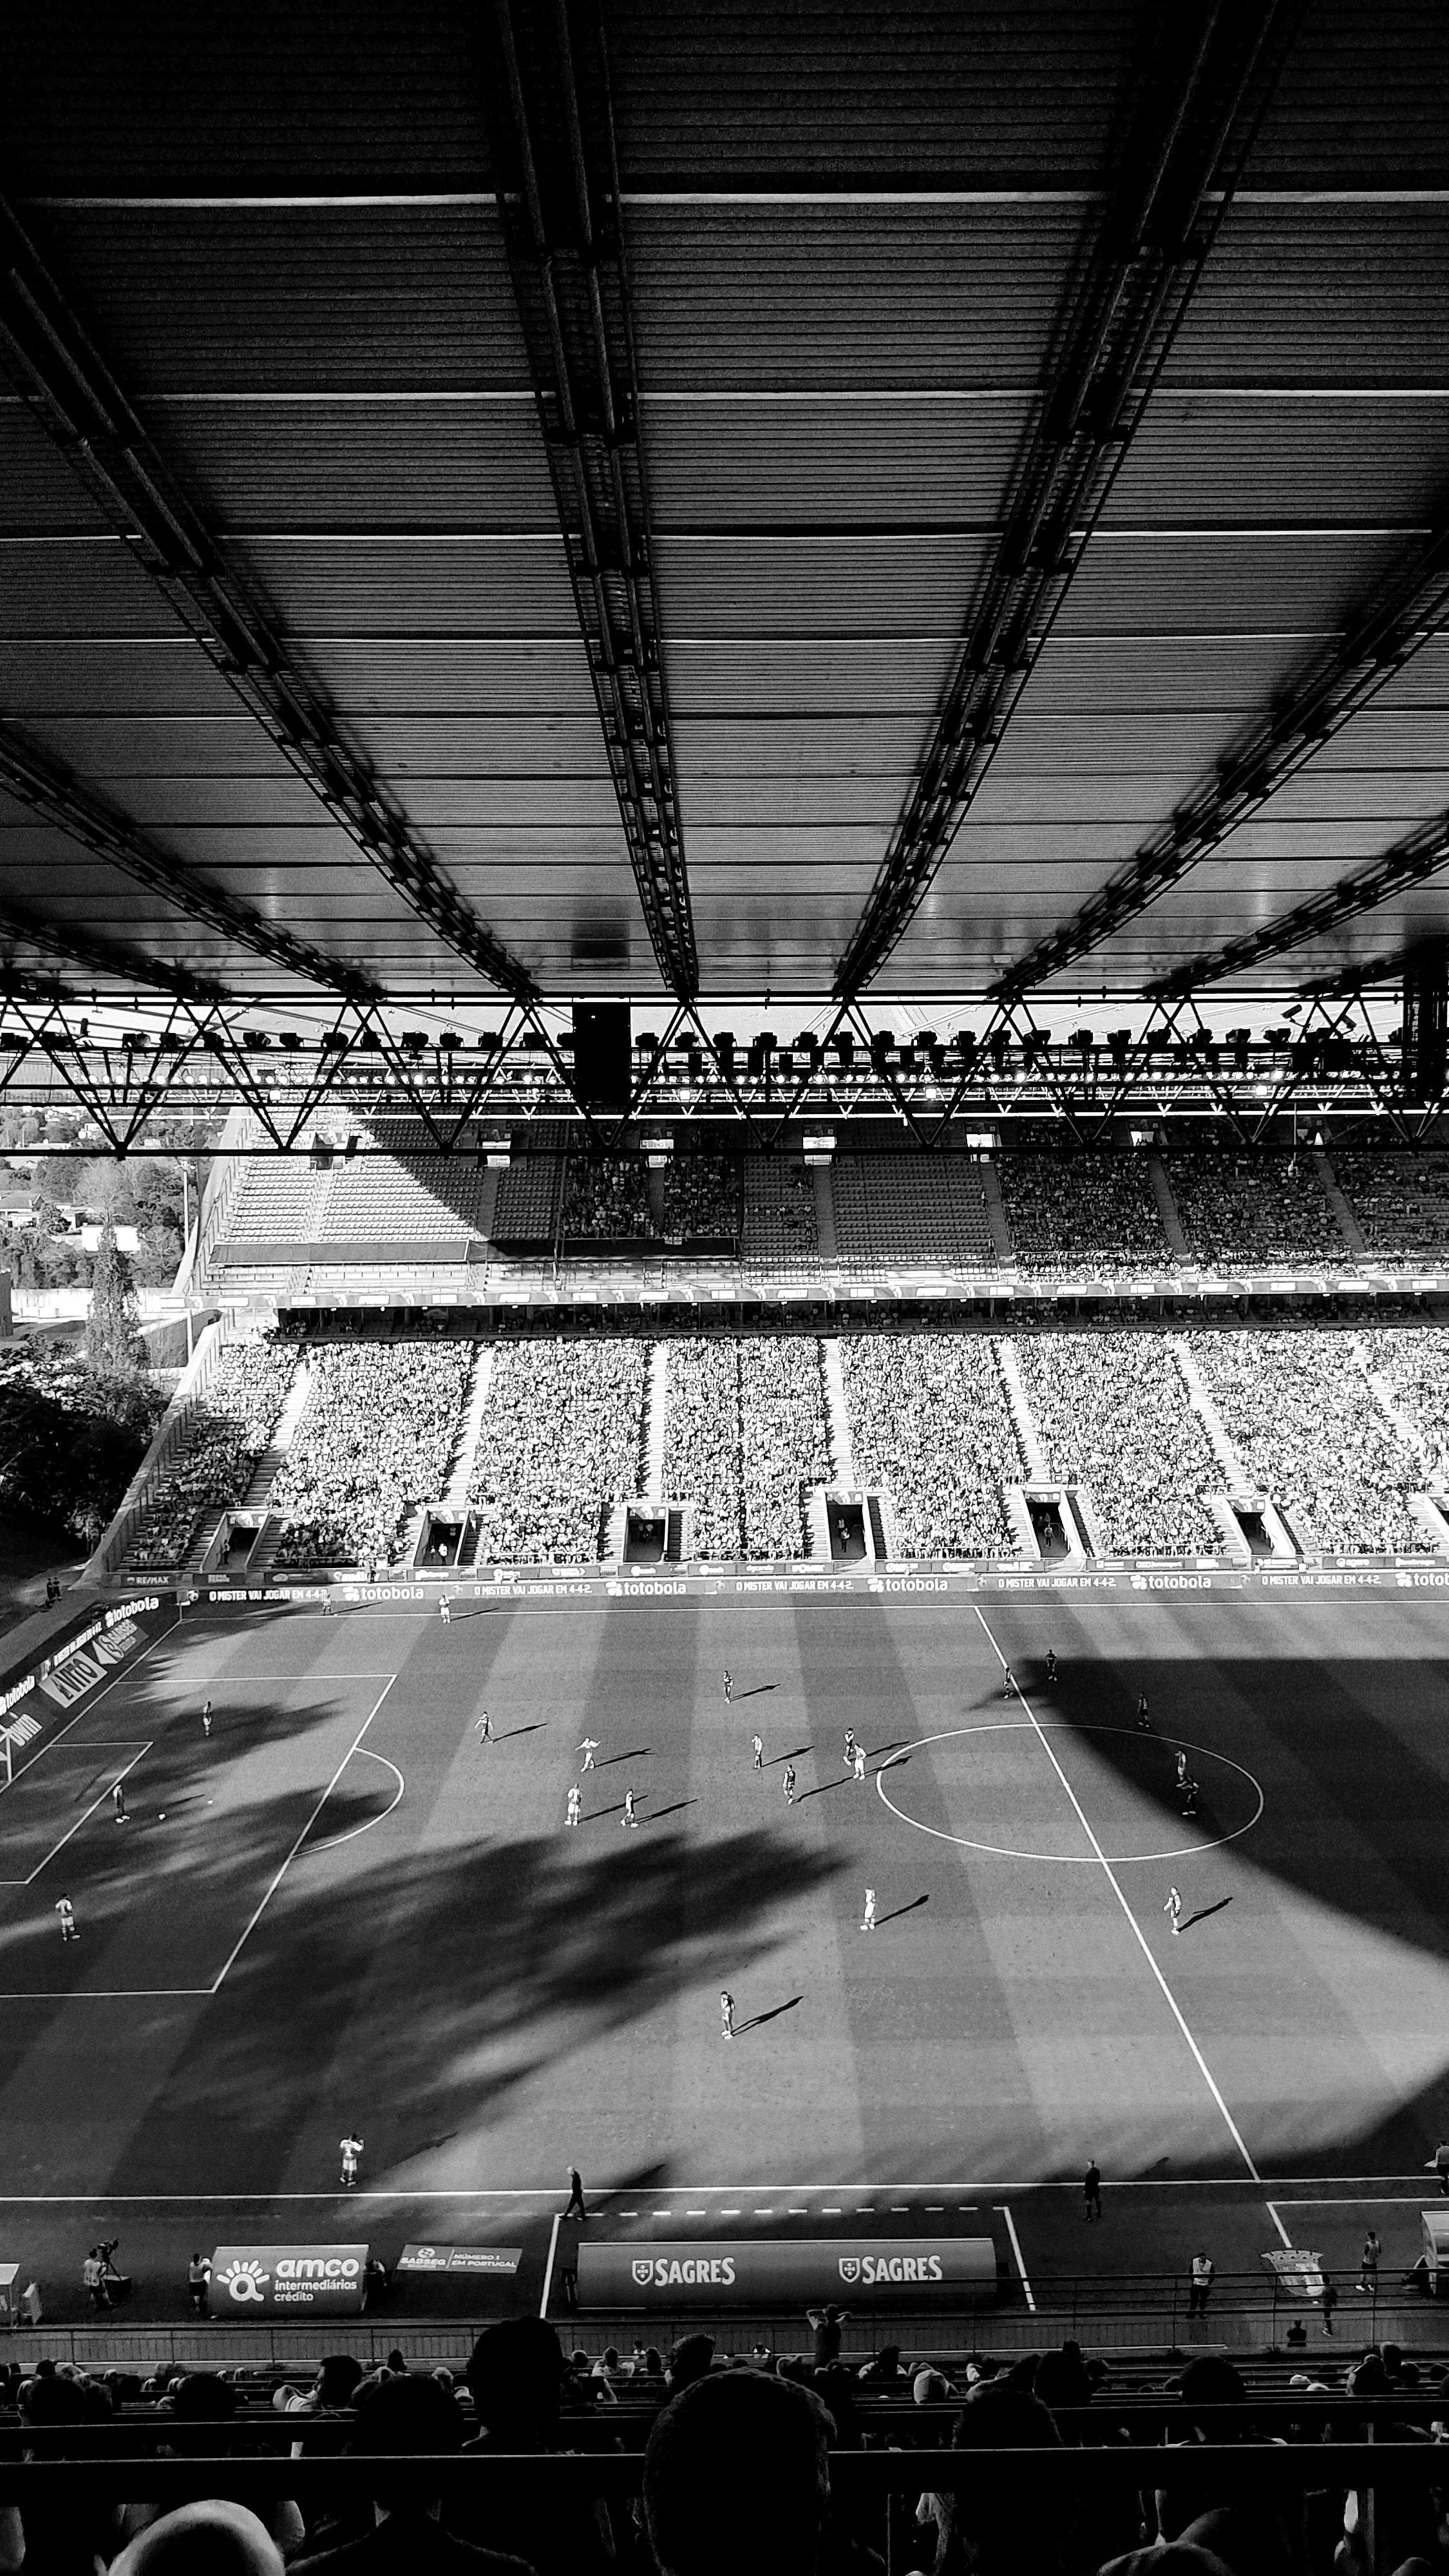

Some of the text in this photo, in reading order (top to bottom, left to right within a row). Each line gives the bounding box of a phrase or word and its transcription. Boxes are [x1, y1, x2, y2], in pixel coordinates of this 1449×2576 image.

[136, 1576, 169, 1584] RE/MAX
[735, 1582, 741, 1591] O
[743, 1581, 773, 1591] MISTER
[774, 1581, 788, 1591] VAI
[789, 1580, 816, 1591] JOGAR
[817, 1580, 829, 1590] EM
[885, 1578, 949, 1591] totobola
[998, 1578, 1005, 1588] O
[1006, 1578, 1035, 1588] MISTER
[1036, 1578, 1050, 1587] VAI
[1051, 1578, 1078, 1587] JOGAR
[1079, 1578, 1092, 1587] EM
[1148, 1575, 1211, 1589] totobola
[1262, 1576, 1268, 1586] O
[1269, 1575, 1298, 1585] MISTER
[1300, 1575, 1314, 1584] VAI
[1315, 1575, 1342, 1584] JOGAR
[1344, 1575, 1356, 1584] EM
[361, 1586, 424, 1600] totobola
[474, 1586, 481, 1595] O
[482, 1585, 511, 1595] MISTER
[513, 1585, 526, 1595] VAI
[527, 1584, 554, 1595] JOGAR
[556, 1584, 567, 1594] EM
[623, 1581, 687, 1595] totobola
[209, 1591, 216, 1602] O
[217, 1590, 247, 1602] MISTER
[248, 1590, 262, 1600] VAI
[263, 1589, 291, 1600] JOGAR
[292, 1589, 304, 1599] EM
[113, 1596, 160, 1623] totobola
[6, 1675, 35, 1710] totobola
[400, 2257, 446, 2266] SABSEG
[276, 2259, 359, 2278] amco
[654, 2257, 736, 2286] SAGRES
[862, 2255, 943, 2284] SAGRES
[274, 2278, 357, 2291] intermediários
[274, 2291, 314, 2302] crédito
